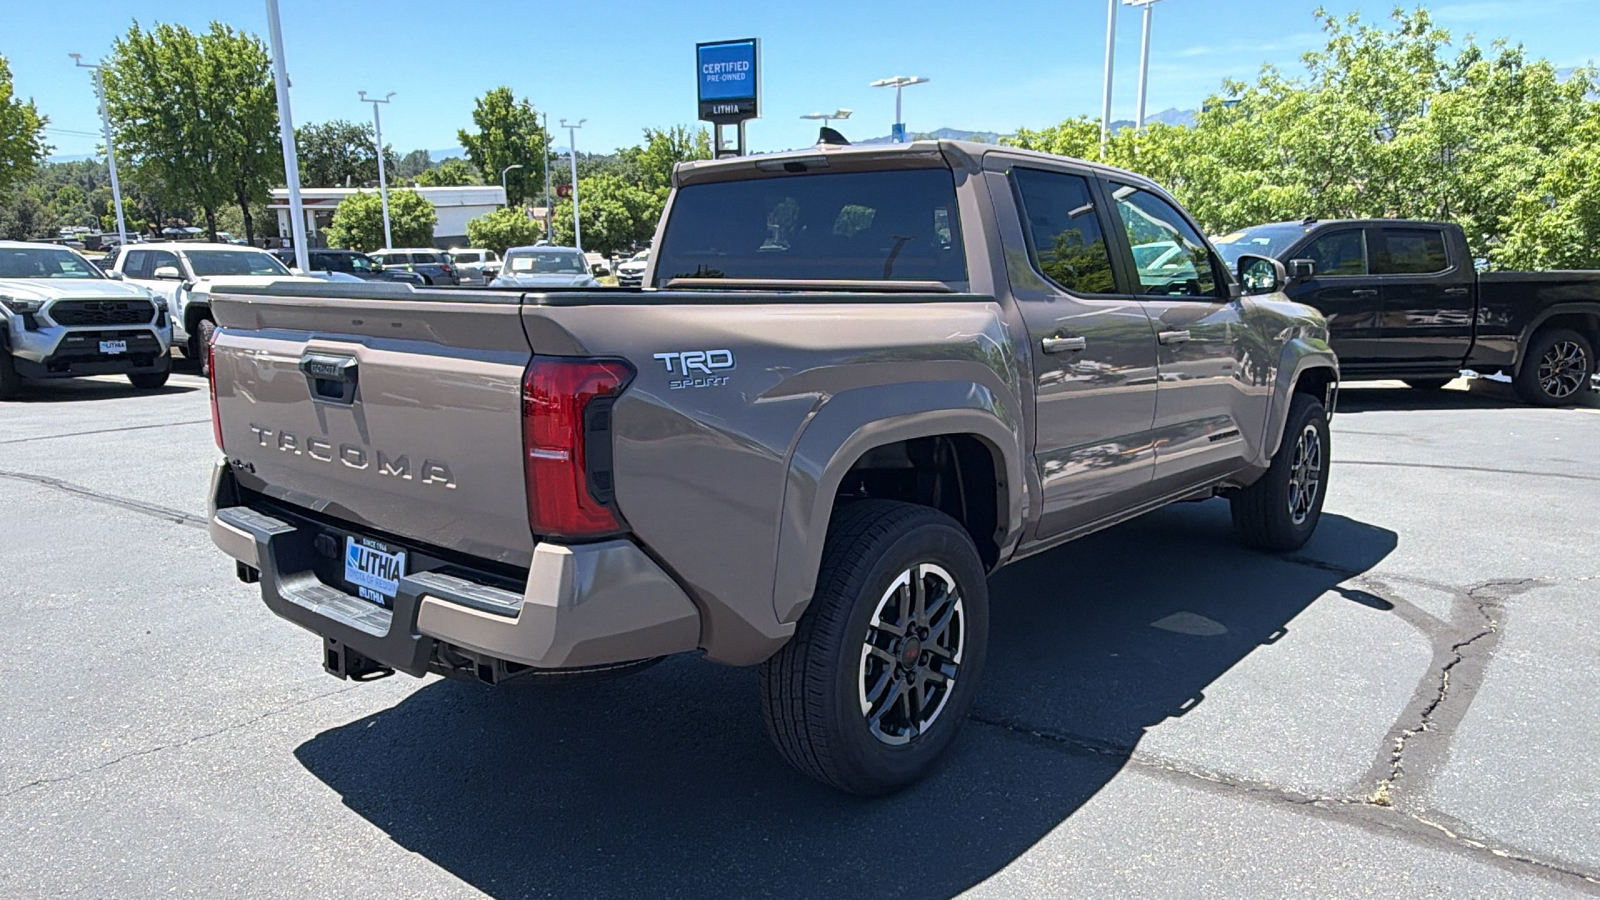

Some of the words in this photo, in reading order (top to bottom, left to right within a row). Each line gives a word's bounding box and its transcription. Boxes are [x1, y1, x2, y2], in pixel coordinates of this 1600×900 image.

[702, 61, 749, 74] CERTIFIED
[706, 72, 746, 82] PRE-OWNED
[713, 104, 739, 115] LITHIA
[653, 349, 734, 376] TRD
[670, 376, 730, 390] SPORT
[249, 422, 457, 490] TACOMA
[362, 538, 376, 549] SINCE
[357, 548, 401, 582] LITHIA
[364, 587, 386, 605] LITHIA
